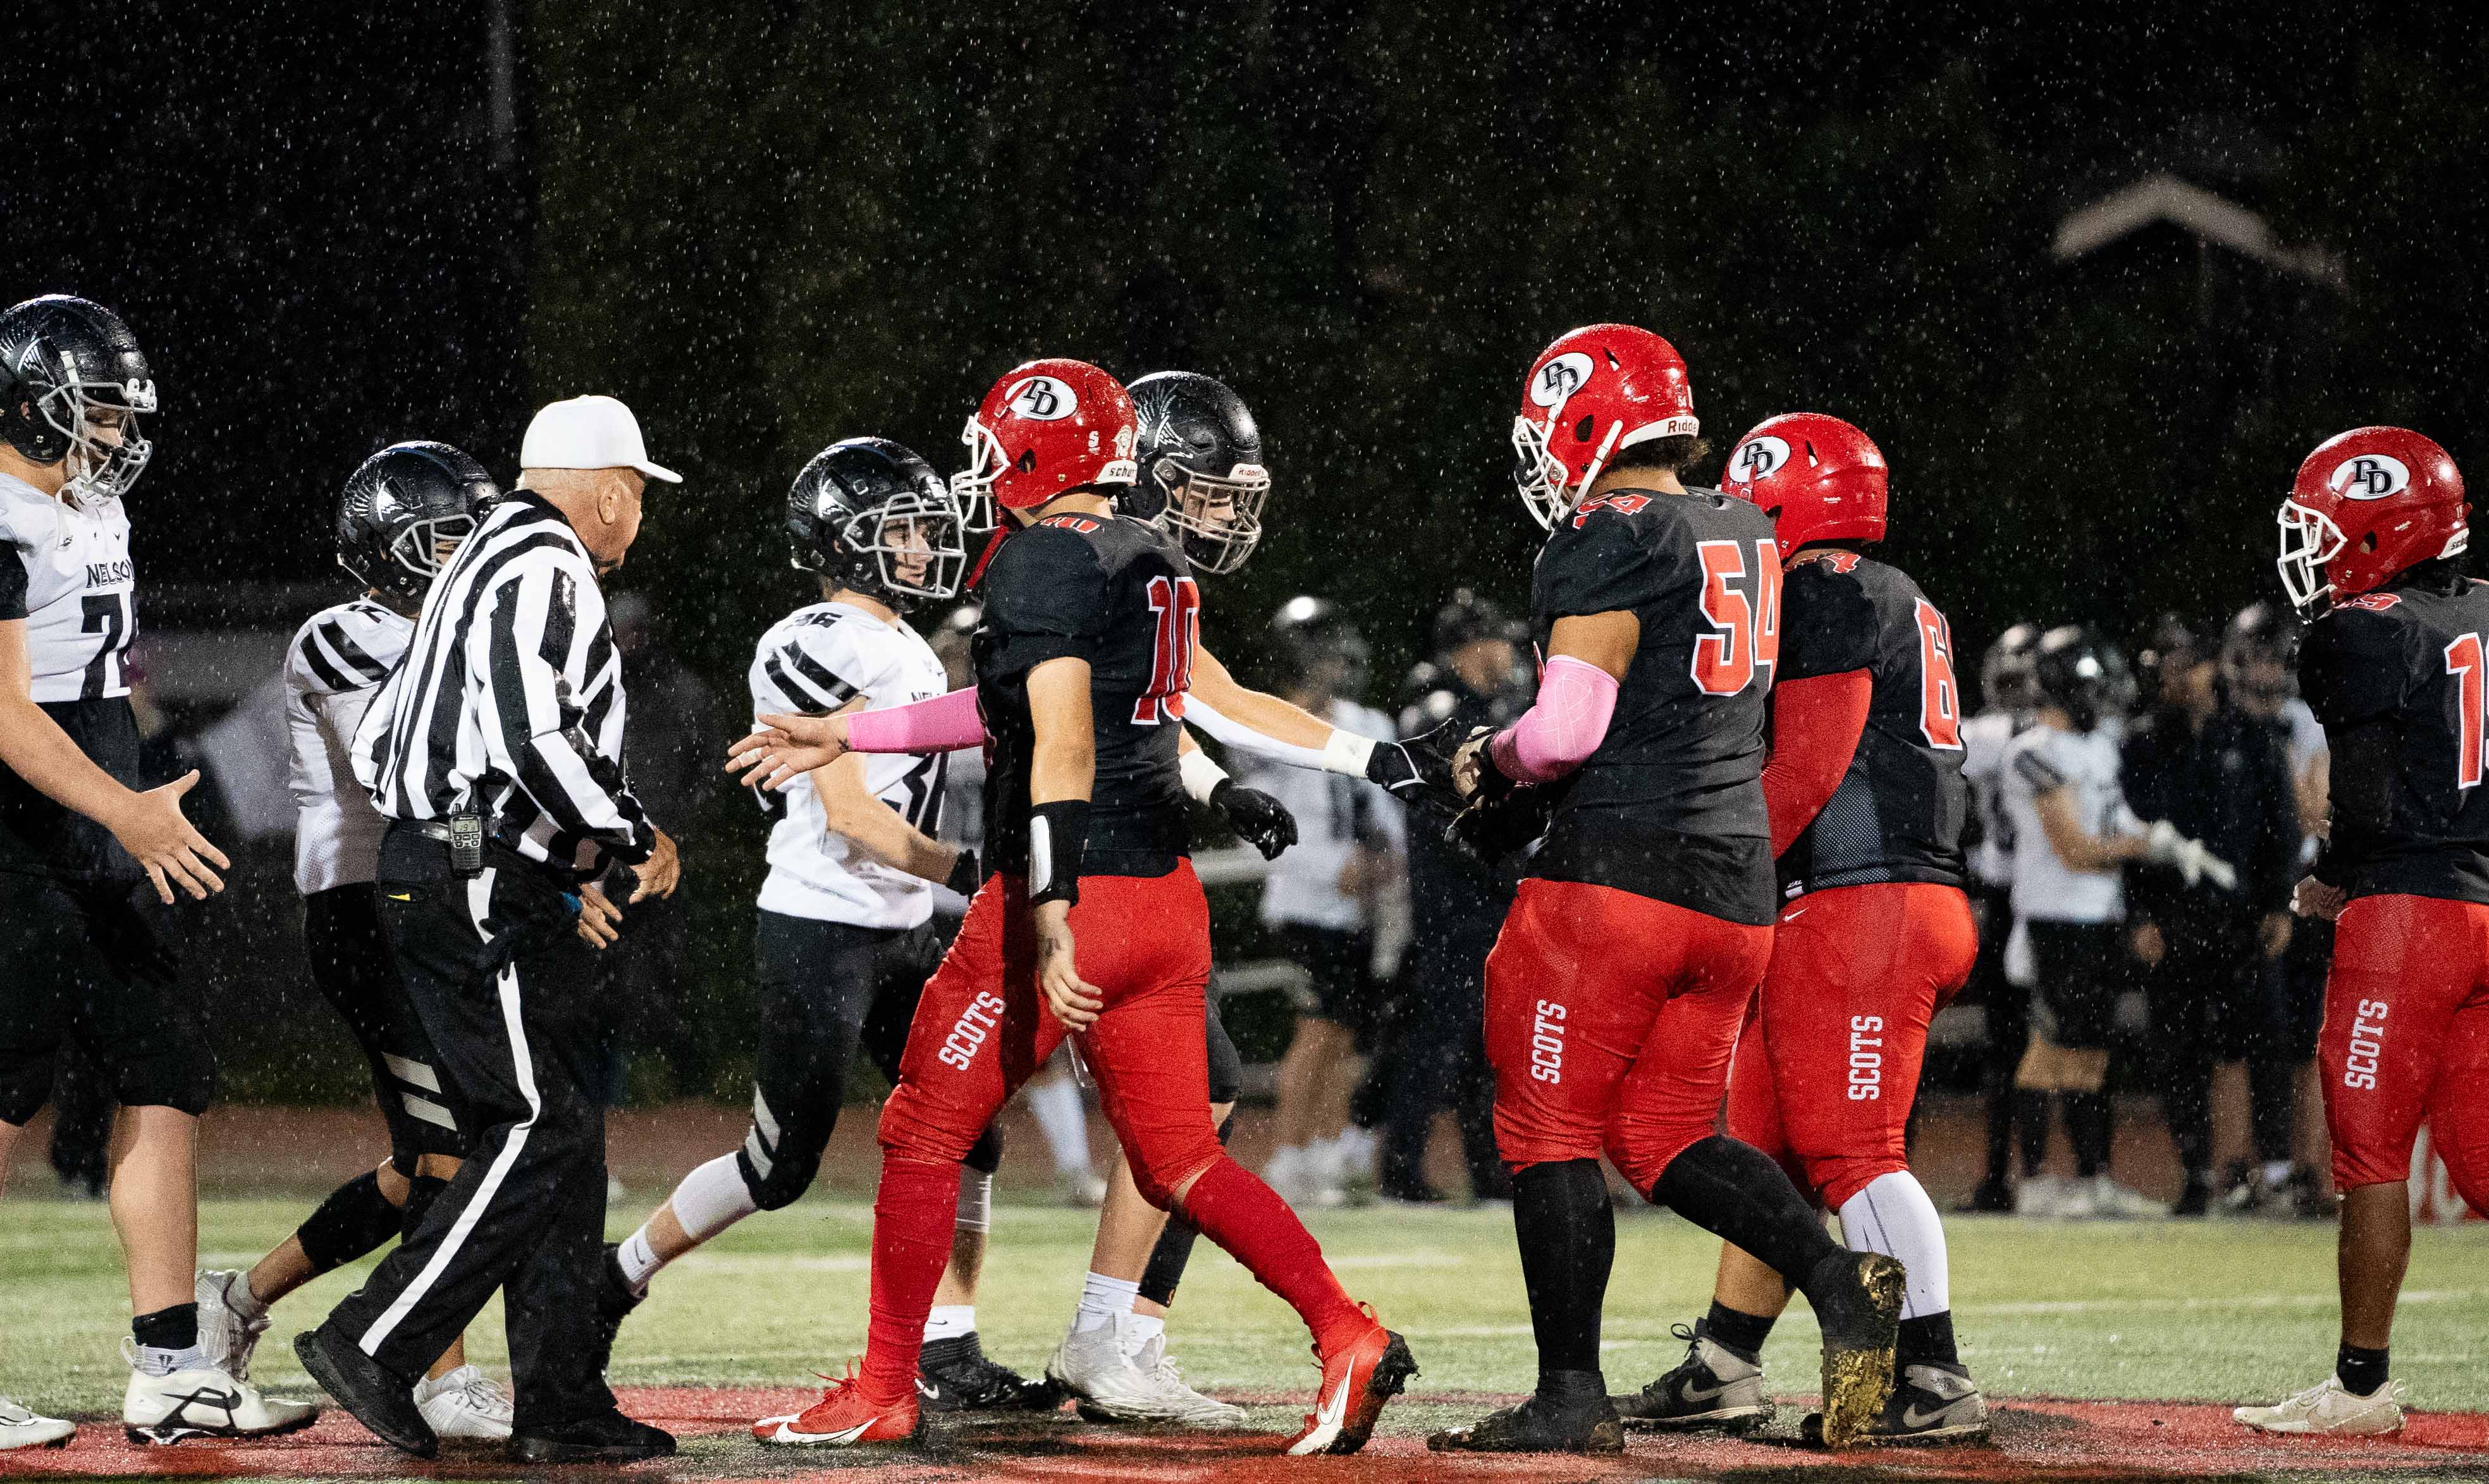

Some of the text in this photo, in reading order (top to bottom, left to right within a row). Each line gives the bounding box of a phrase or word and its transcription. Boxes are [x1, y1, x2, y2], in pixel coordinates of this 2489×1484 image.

[1130, 575, 1200, 725] 10
[1690, 538, 1784, 696] 54
[2443, 632, 2489, 790] 1
[938, 990, 1007, 1070] SCOTS
[1531, 999, 1566, 1084] SCOTS
[1848, 1015, 1883, 1100] SCOTS
[2344, 998, 2388, 1090] SCOTS
